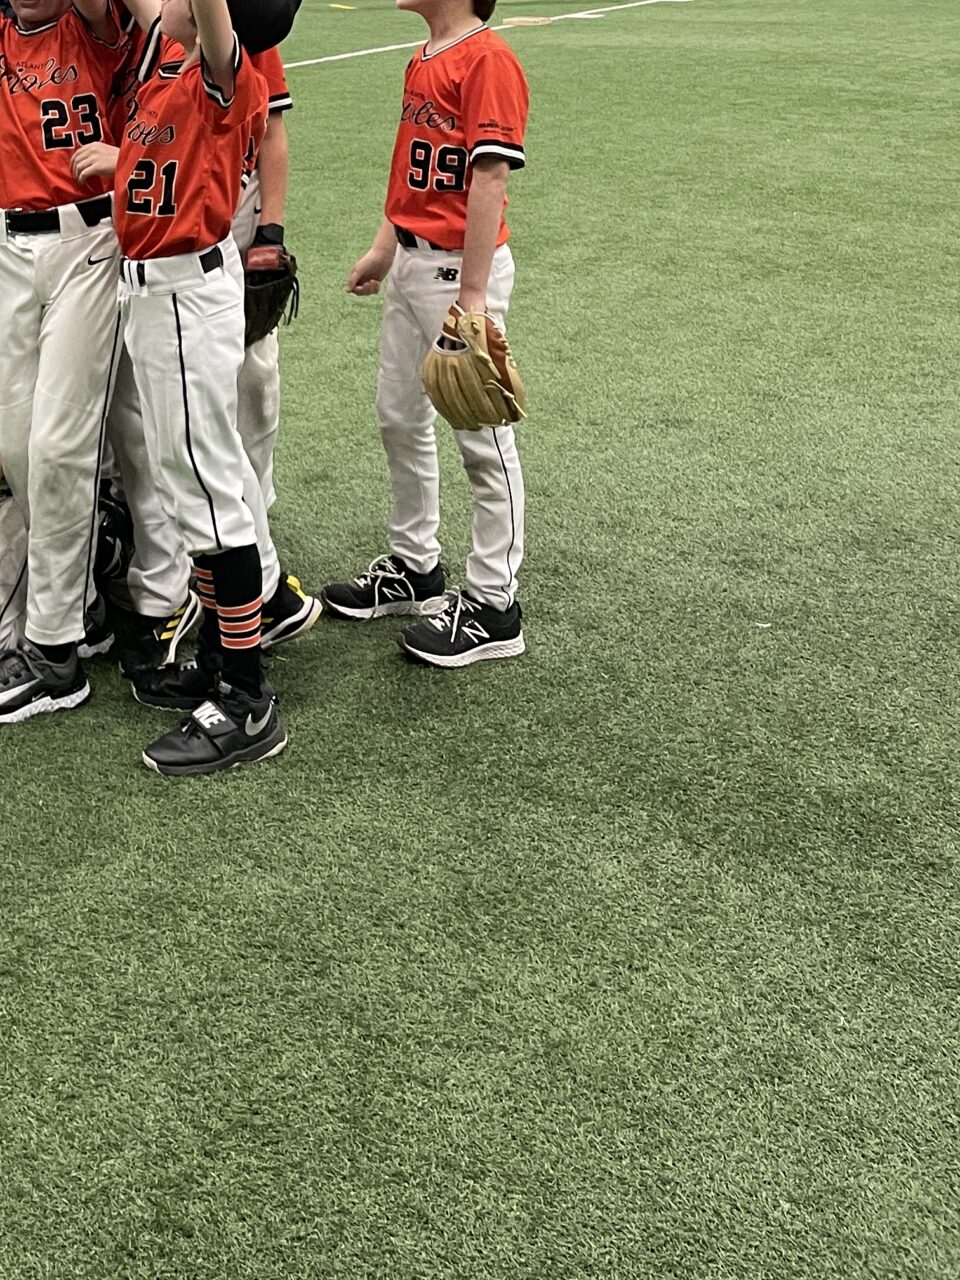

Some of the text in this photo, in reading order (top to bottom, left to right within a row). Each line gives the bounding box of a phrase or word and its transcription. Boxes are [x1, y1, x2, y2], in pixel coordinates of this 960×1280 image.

[40, 92, 104, 151] 23
[125, 158, 179, 217] 21
[407, 137, 469, 193] 99
